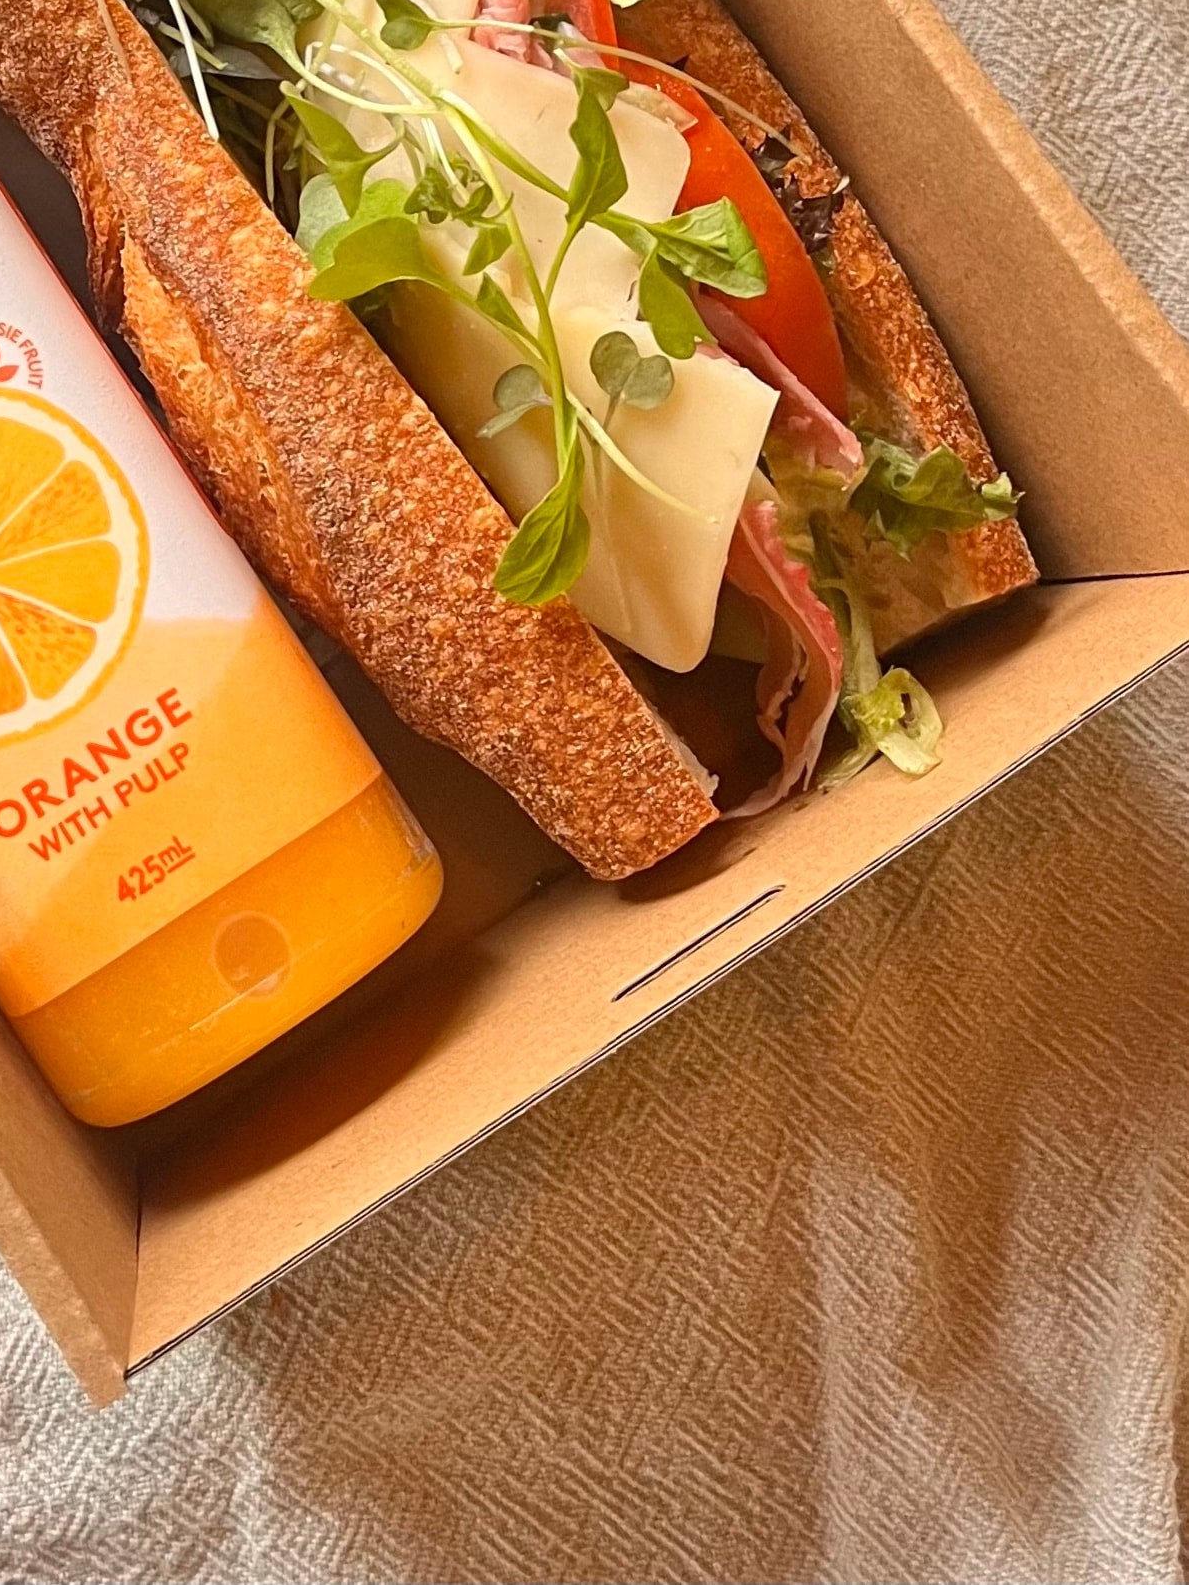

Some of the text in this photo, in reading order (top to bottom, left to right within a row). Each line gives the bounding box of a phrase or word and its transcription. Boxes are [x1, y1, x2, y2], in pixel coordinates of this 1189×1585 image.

[18, 338, 44, 390] FRUIT
[27, 742, 190, 862] WITH PULP
[117, 835, 196, 902] 425mL
